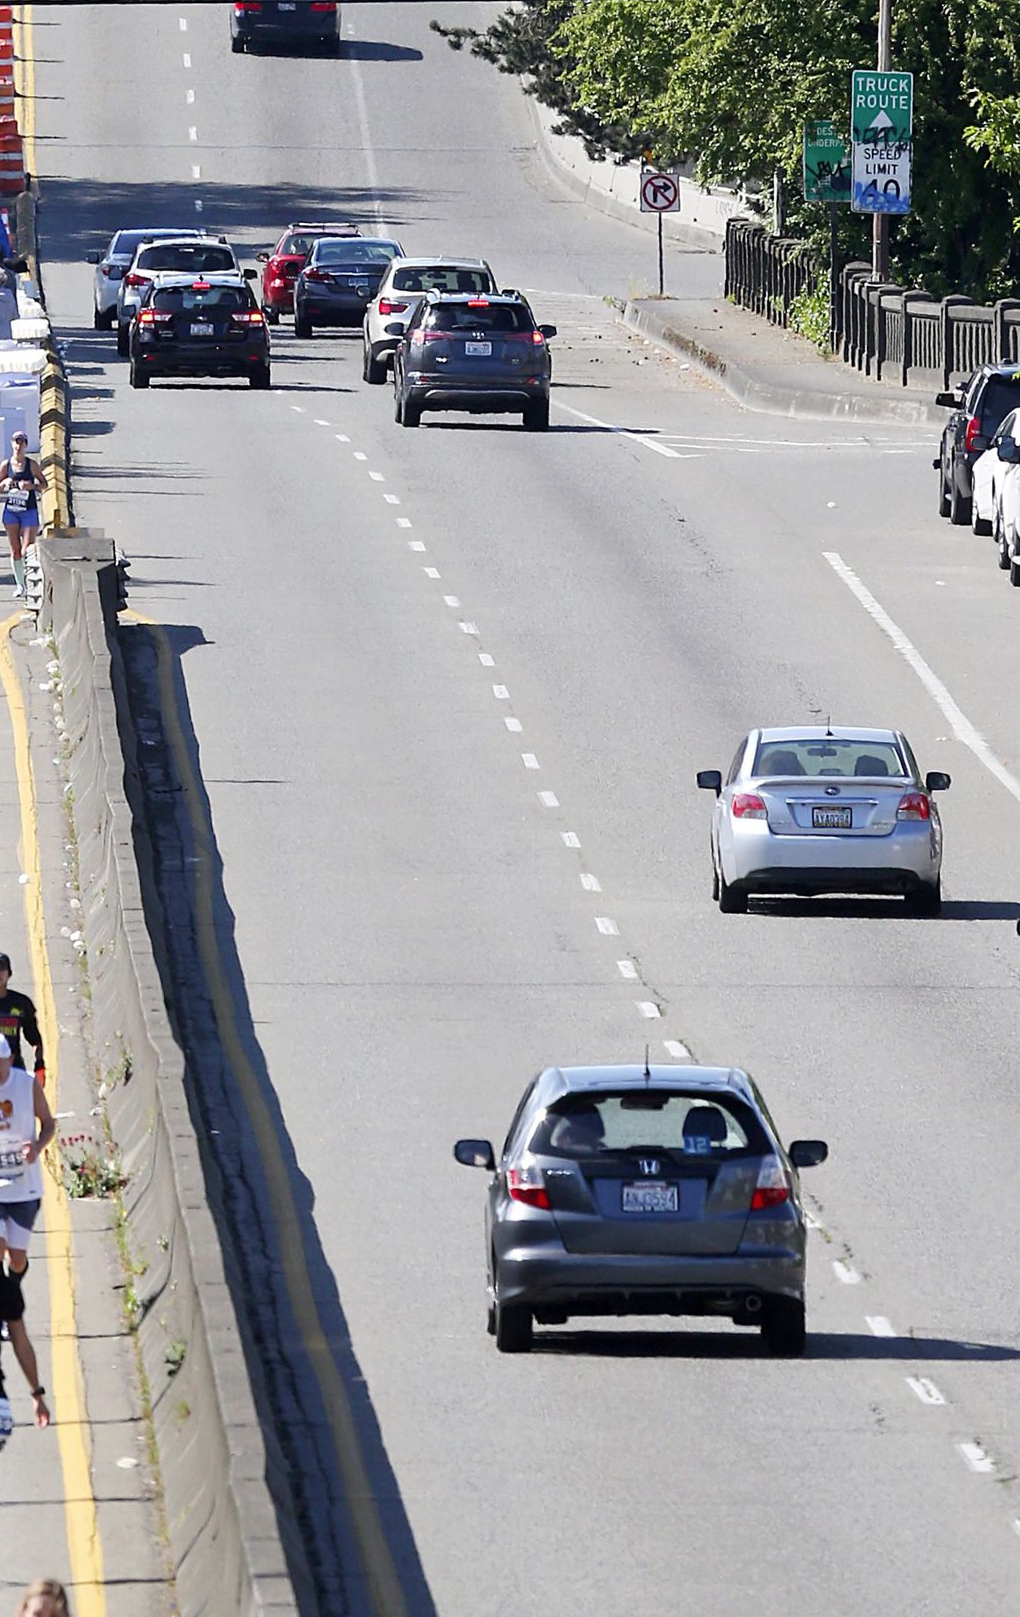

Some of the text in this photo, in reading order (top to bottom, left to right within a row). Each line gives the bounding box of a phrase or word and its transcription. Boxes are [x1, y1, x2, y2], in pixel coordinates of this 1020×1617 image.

[856, 77, 909, 93] TRUCK
[856, 94, 909, 110] ROUTE
[864, 147, 902, 160] SPEED
[866, 163, 899, 175] LIMIT
[688, 1136, 708, 1154] 12
